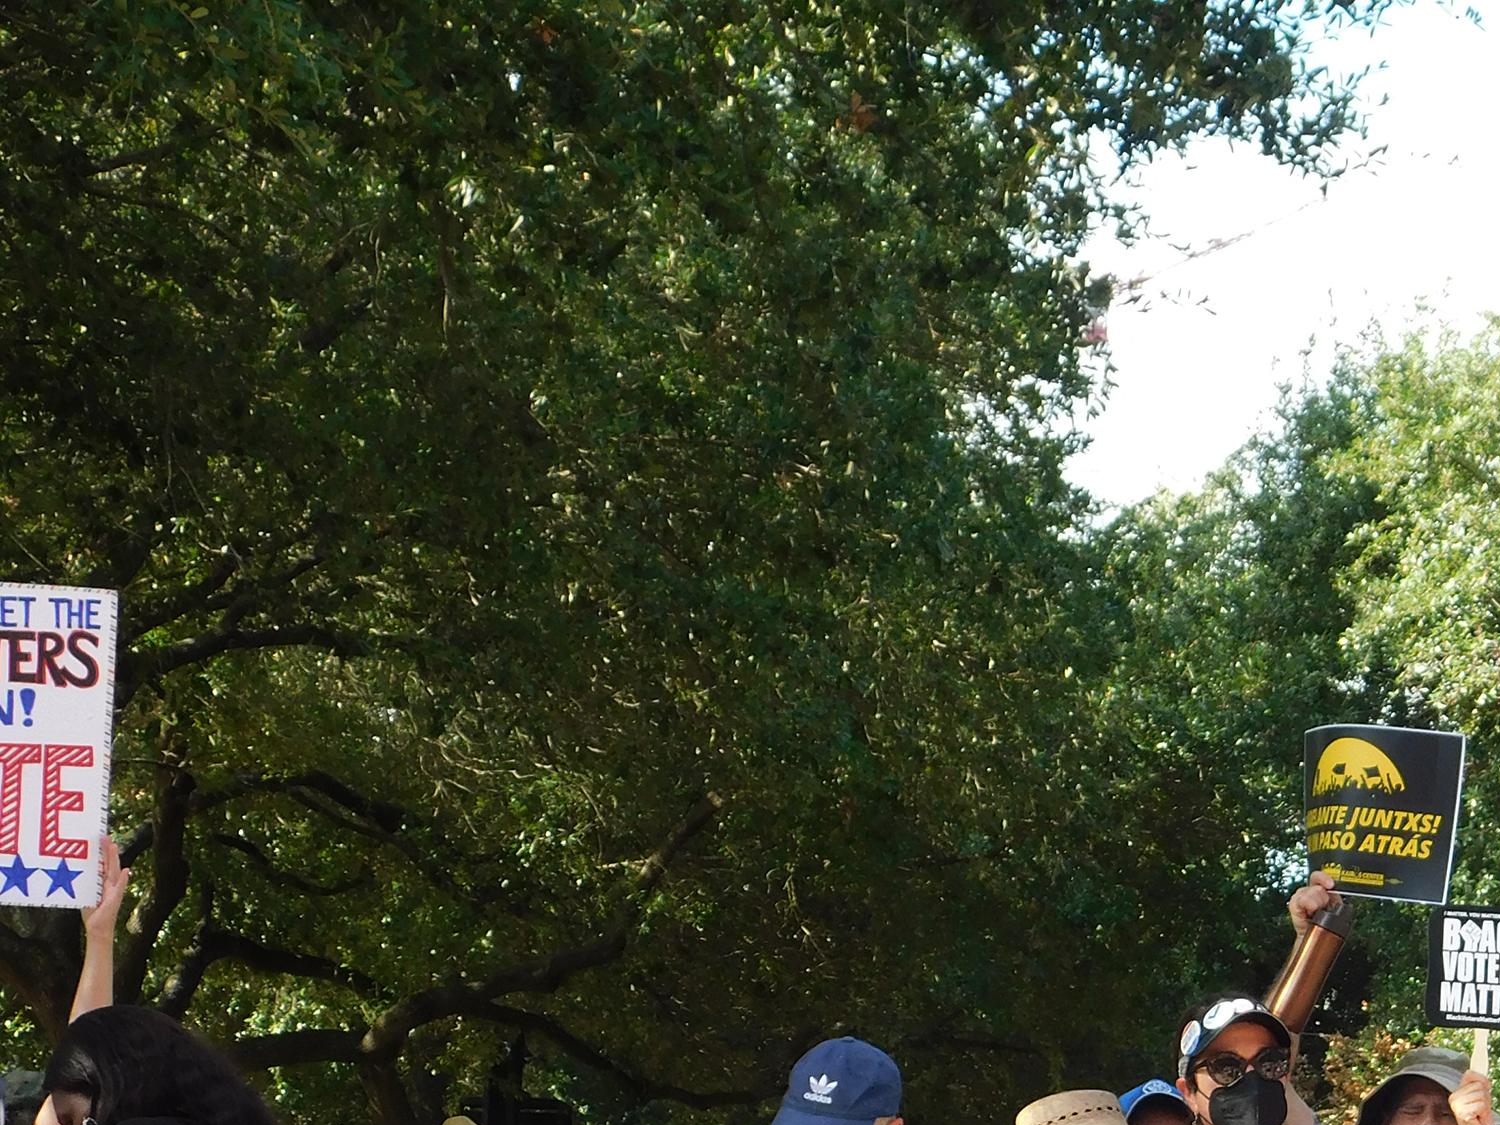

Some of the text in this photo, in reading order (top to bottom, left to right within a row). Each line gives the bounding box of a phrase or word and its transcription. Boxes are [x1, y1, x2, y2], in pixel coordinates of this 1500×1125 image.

[0, 596, 101, 629] ET THE
[0, 688, 36, 728] N!
[0, 744, 94, 859] TE
[1345, 806, 1442, 834] JUNTXS!
[1358, 833, 1433, 859] ATRÁS
